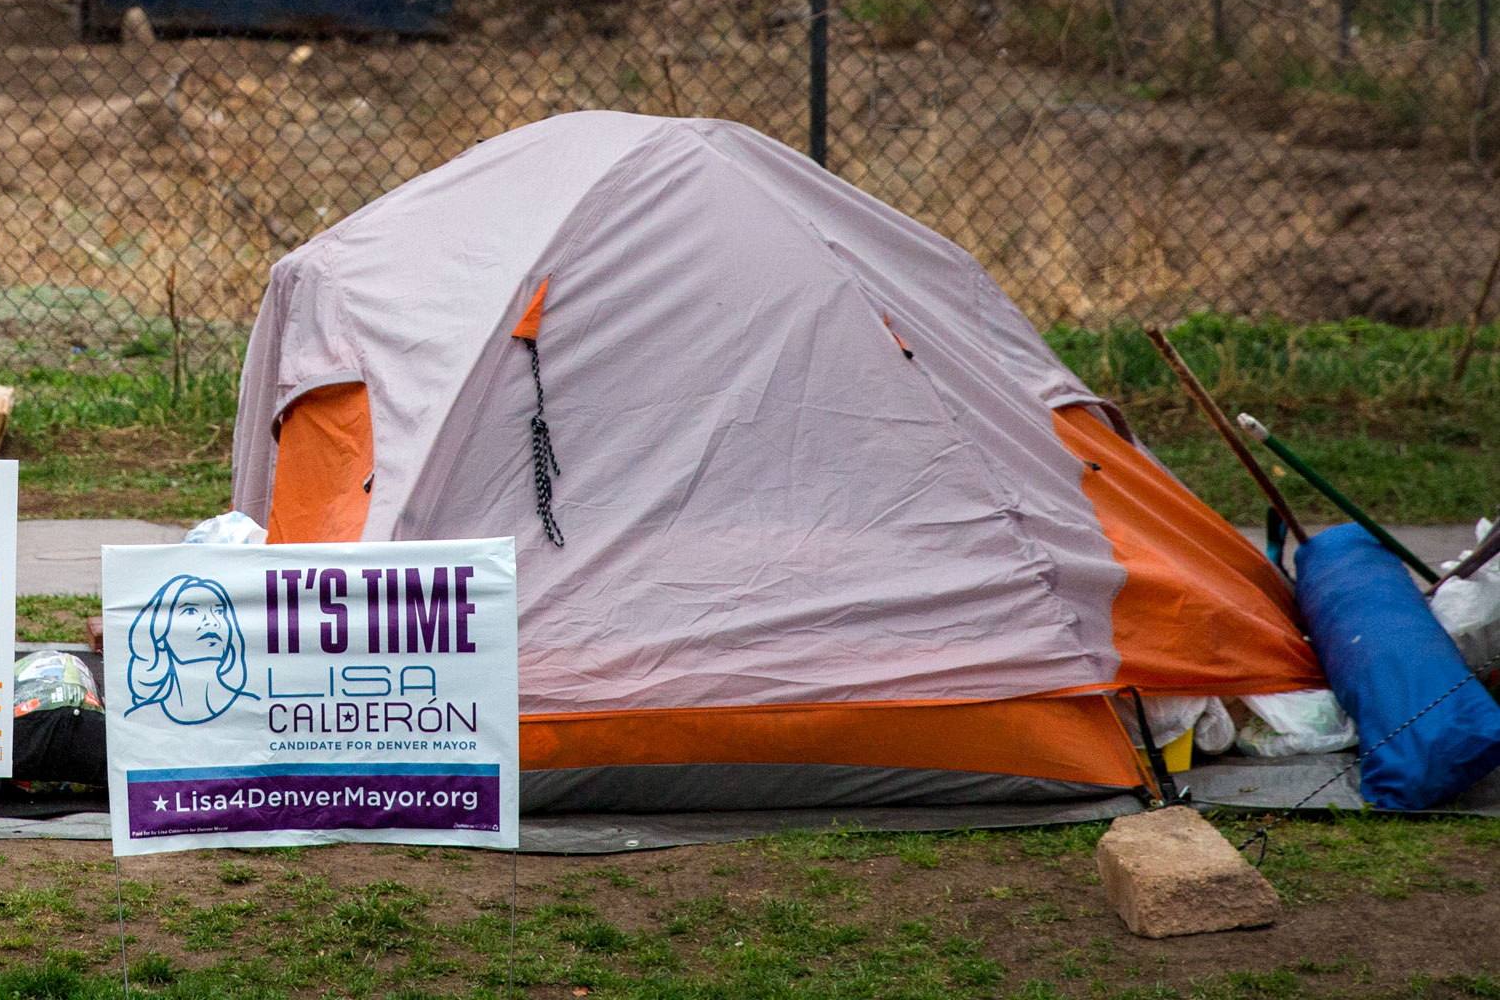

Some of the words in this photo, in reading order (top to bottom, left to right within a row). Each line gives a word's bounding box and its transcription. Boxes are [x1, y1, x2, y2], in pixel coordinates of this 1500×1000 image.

[266, 568, 349, 654] IT'S
[362, 566, 476, 654] TIME
[268, 665, 437, 698] LISA
[268, 697, 477, 733] CALDERÓN
[269, 741, 342, 751] CANDIDATE
[346, 741, 373, 751] FOR
[377, 741, 428, 750] DENVER
[432, 741, 477, 750] MAYOR
[175, 785, 478, 812] Lisa4DenverMayor.org
